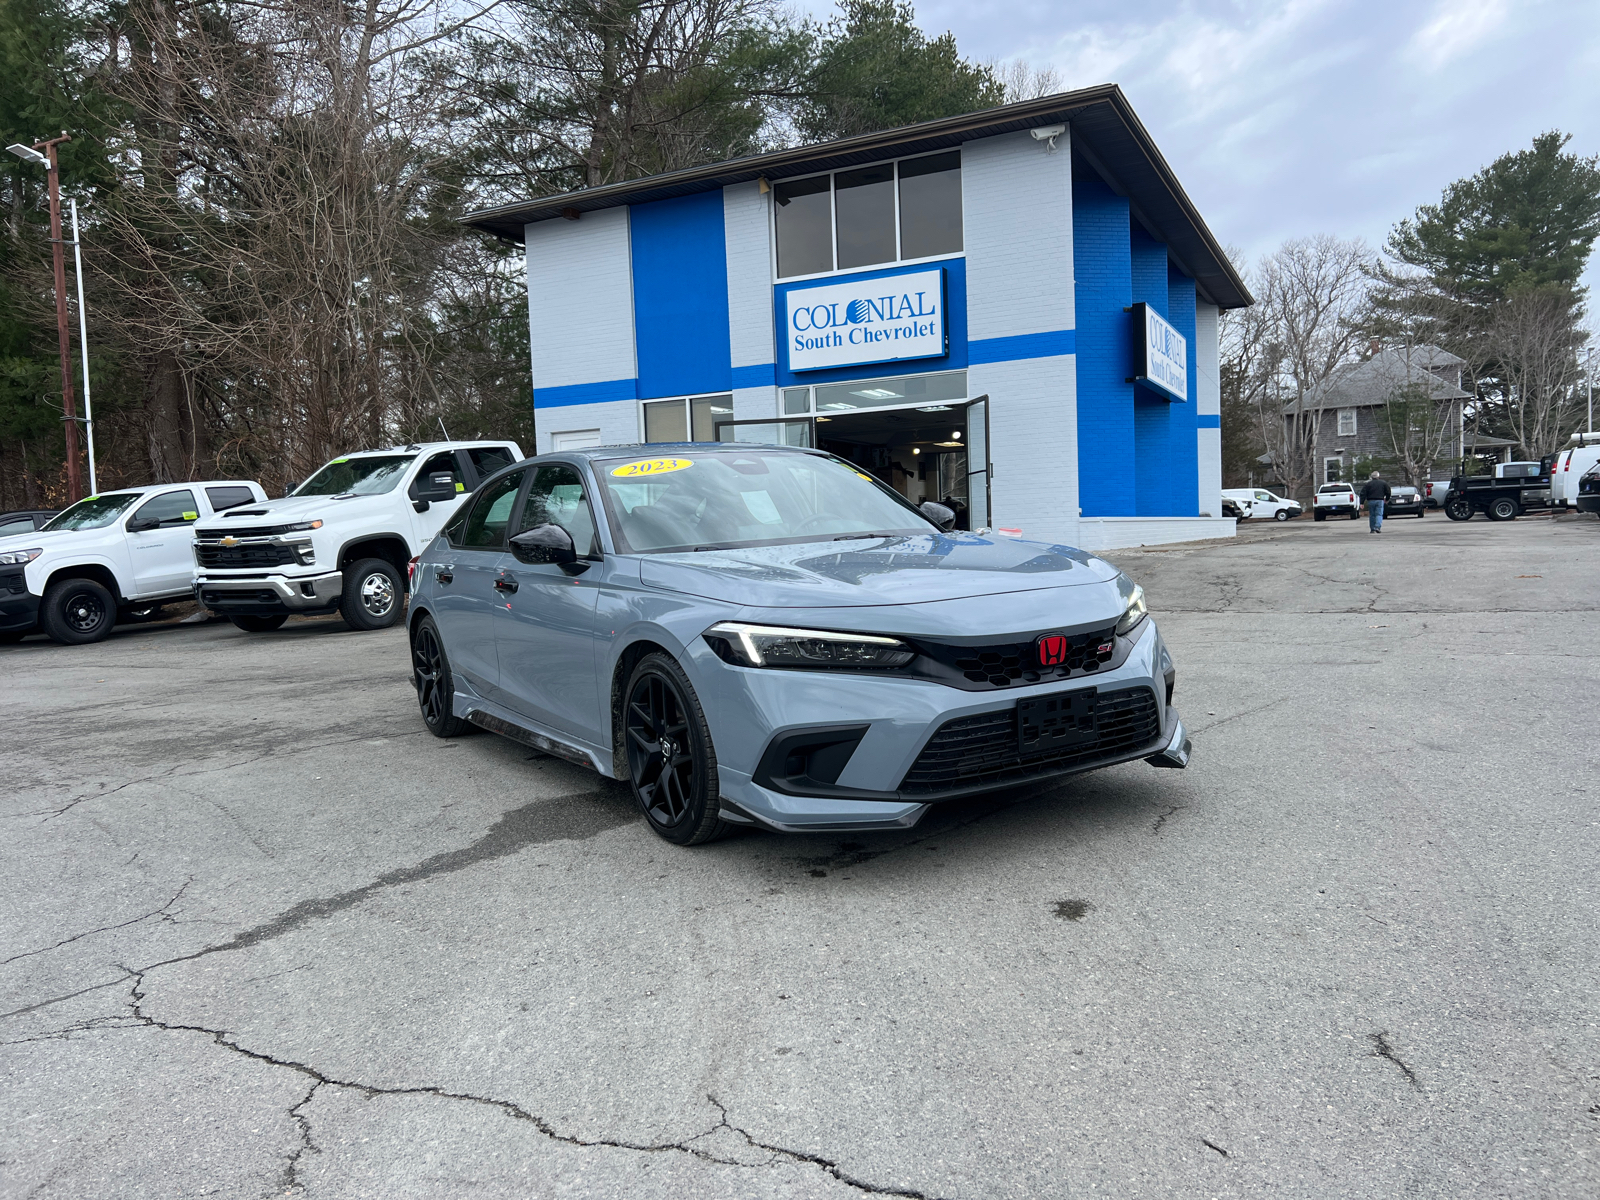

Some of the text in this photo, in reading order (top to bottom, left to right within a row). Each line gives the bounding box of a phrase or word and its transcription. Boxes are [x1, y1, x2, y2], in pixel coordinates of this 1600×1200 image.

[792, 291, 936, 331] COLONIAL
[795, 320, 936, 351] South Chevrolet
[627, 460, 678, 476] 2023
